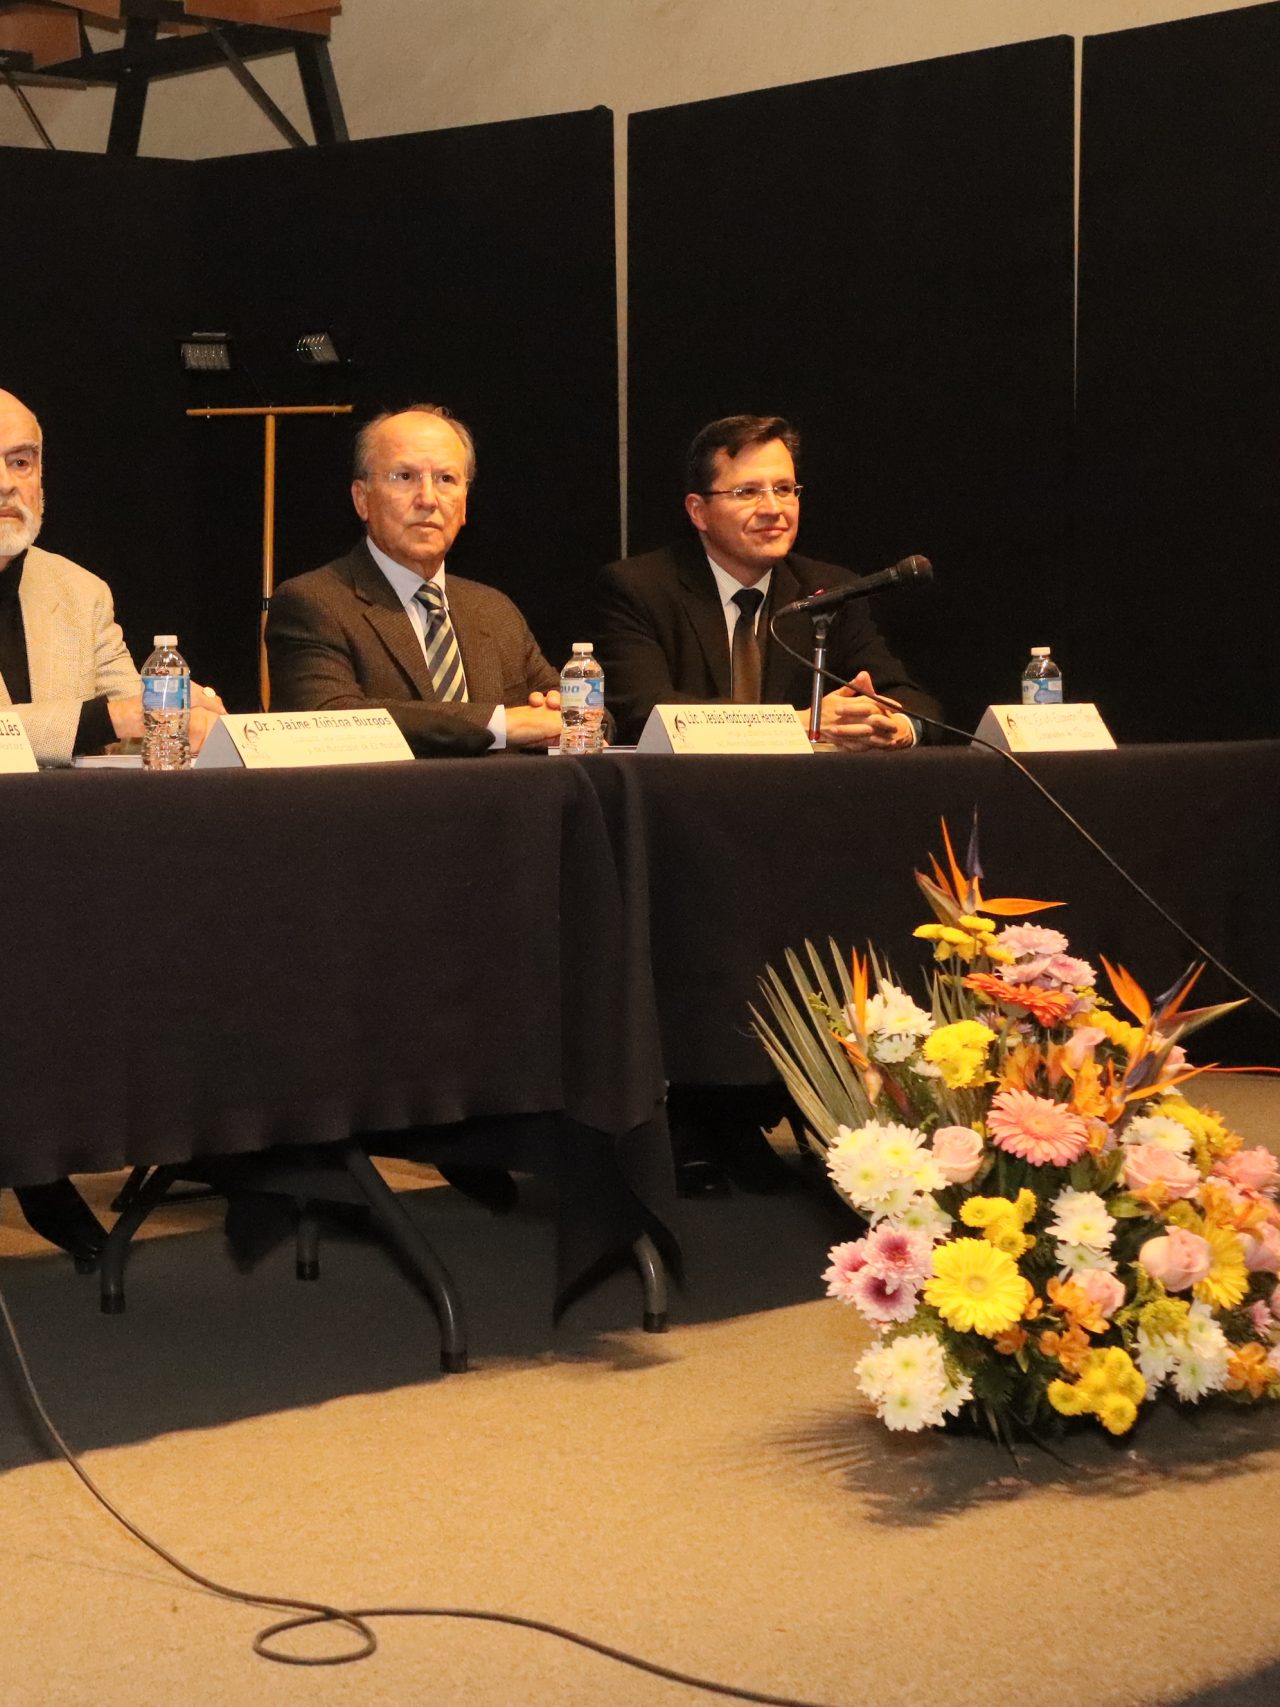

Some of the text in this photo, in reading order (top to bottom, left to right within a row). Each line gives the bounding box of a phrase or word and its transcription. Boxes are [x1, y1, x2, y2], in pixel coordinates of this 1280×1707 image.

[253, 715, 392, 732] Dr. Jaime Zúñiga Burgos
[684, 711, 703, 724] Lic.
